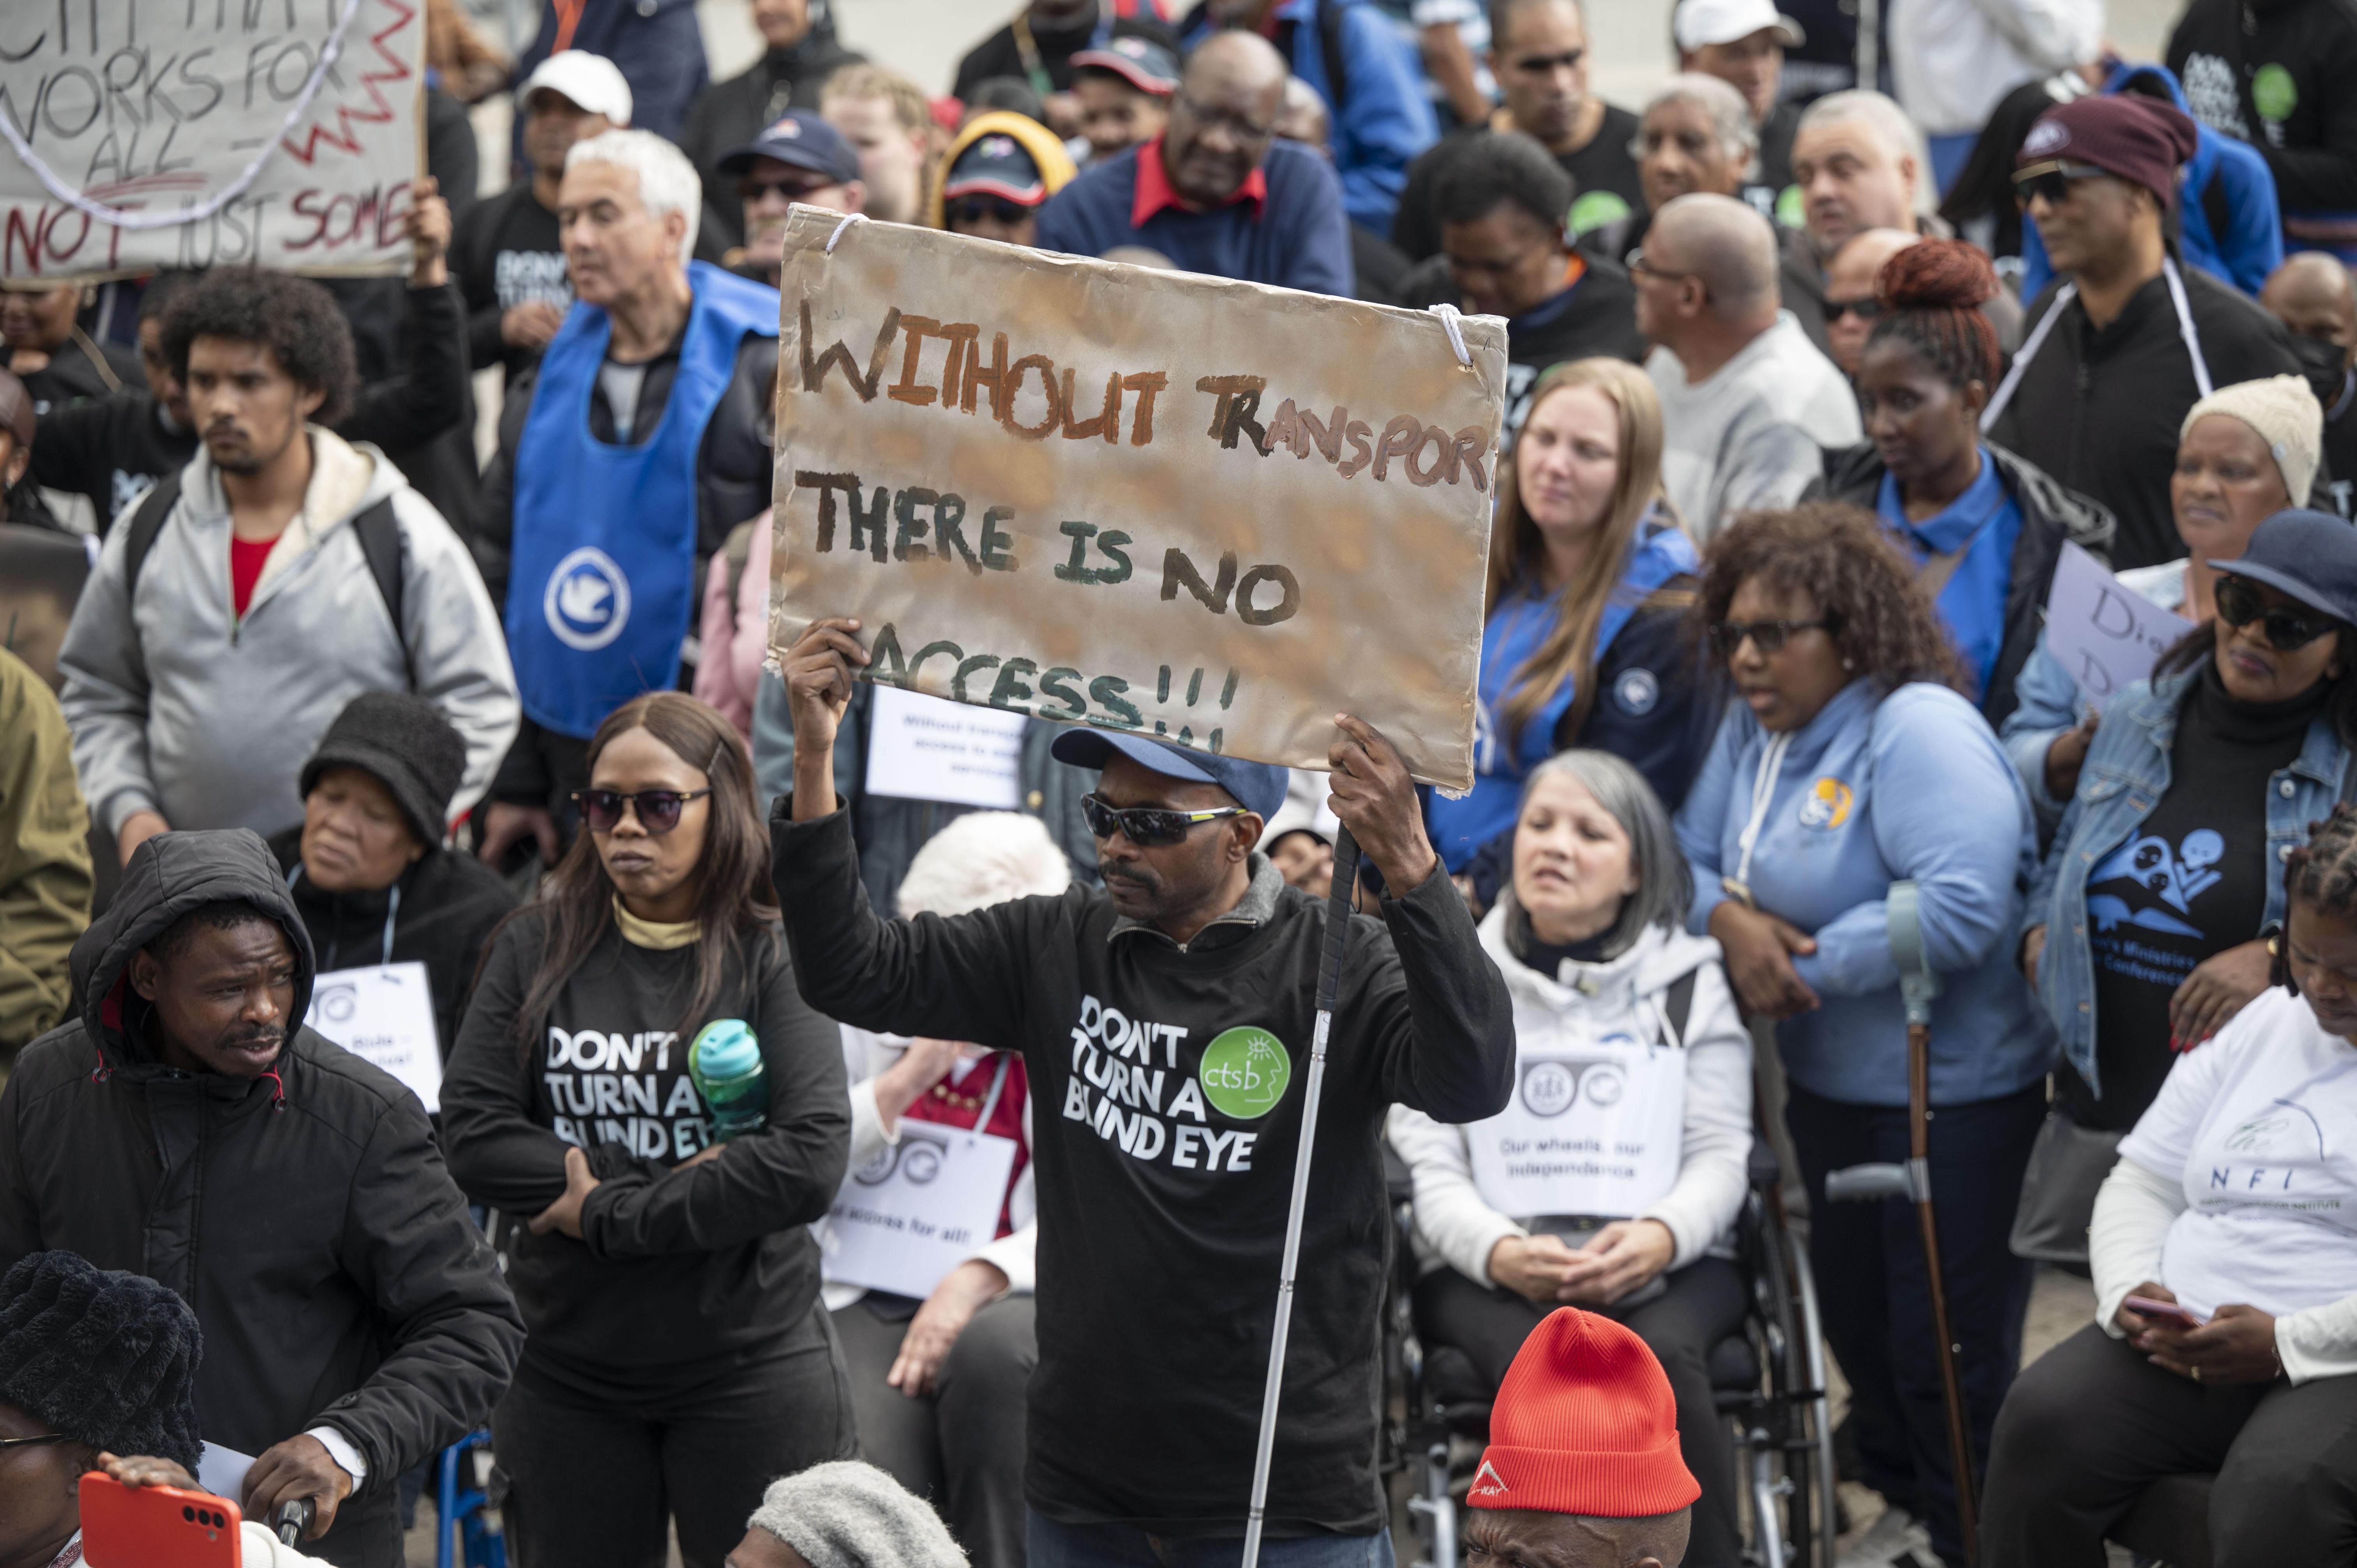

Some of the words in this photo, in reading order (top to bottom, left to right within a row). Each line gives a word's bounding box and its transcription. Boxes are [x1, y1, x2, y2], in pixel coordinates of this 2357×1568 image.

[244, 36, 347, 109] FOR
[83, 120, 194, 184] ALL
[4, 197, 148, 276] NOT
[283, 181, 413, 251] SOME
[799, 298, 1168, 447] WITHOUT
[1195, 375, 1500, 501] TRANSPOR
[795, 469, 1020, 576] THERE
[1054, 520, 1133, 584] IS
[1161, 547, 1300, 626] NO
[547, 1026, 679, 1072] DON'T
[1079, 994, 1189, 1069] DON'T
[545, 1072, 659, 1116] TURN
[663, 1075, 701, 1117] A
[1070, 1027, 1165, 1113] TURN
[1166, 1077, 1207, 1123] A
[1204, 1060, 1261, 1090] ctsb
[1062, 1075, 1166, 1160] BLIND
[1172, 1125, 1258, 1171] EYE
